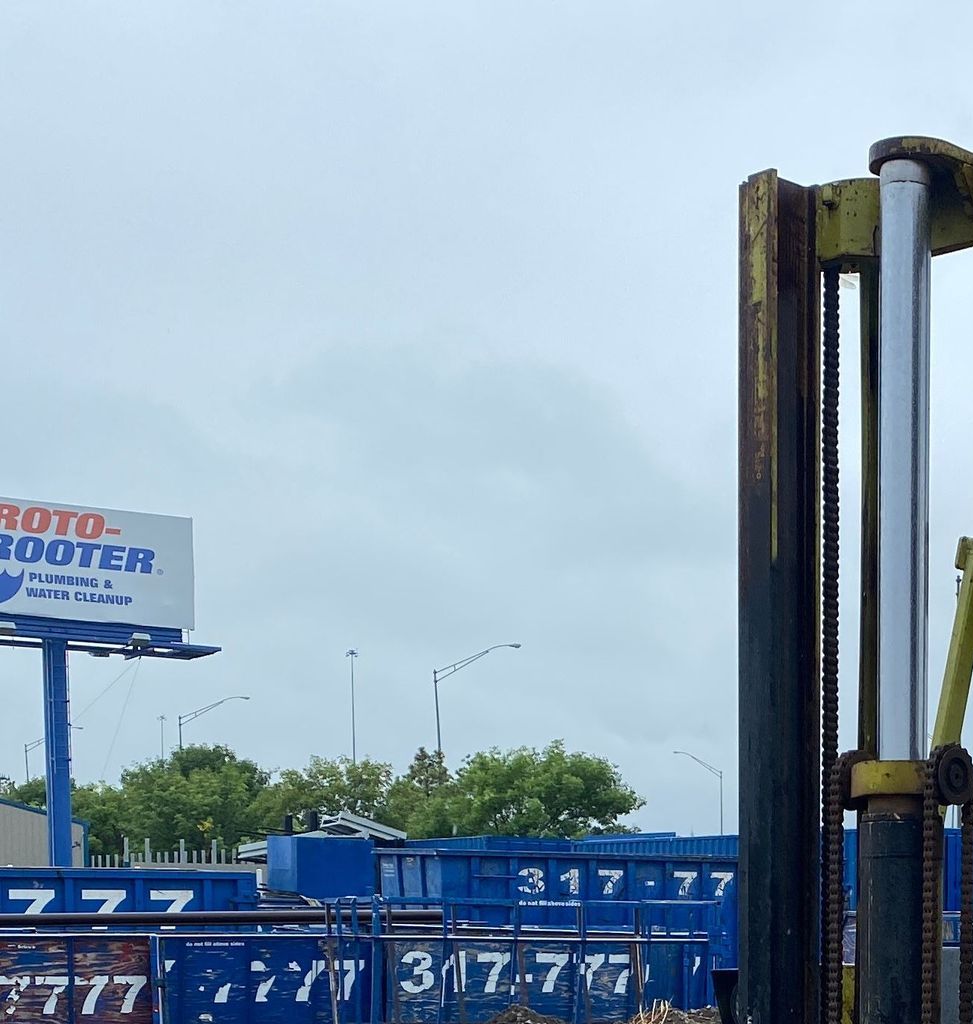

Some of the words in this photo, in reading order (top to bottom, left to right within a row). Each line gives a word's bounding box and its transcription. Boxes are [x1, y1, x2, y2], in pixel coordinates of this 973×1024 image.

[0, 503, 121, 540] ROTO-
[29, 572, 99, 588] PLUMBING
[104, 579, 113, 589] &
[26, 587, 70, 601] WATER
[74, 591, 133, 606] CLEANUP
